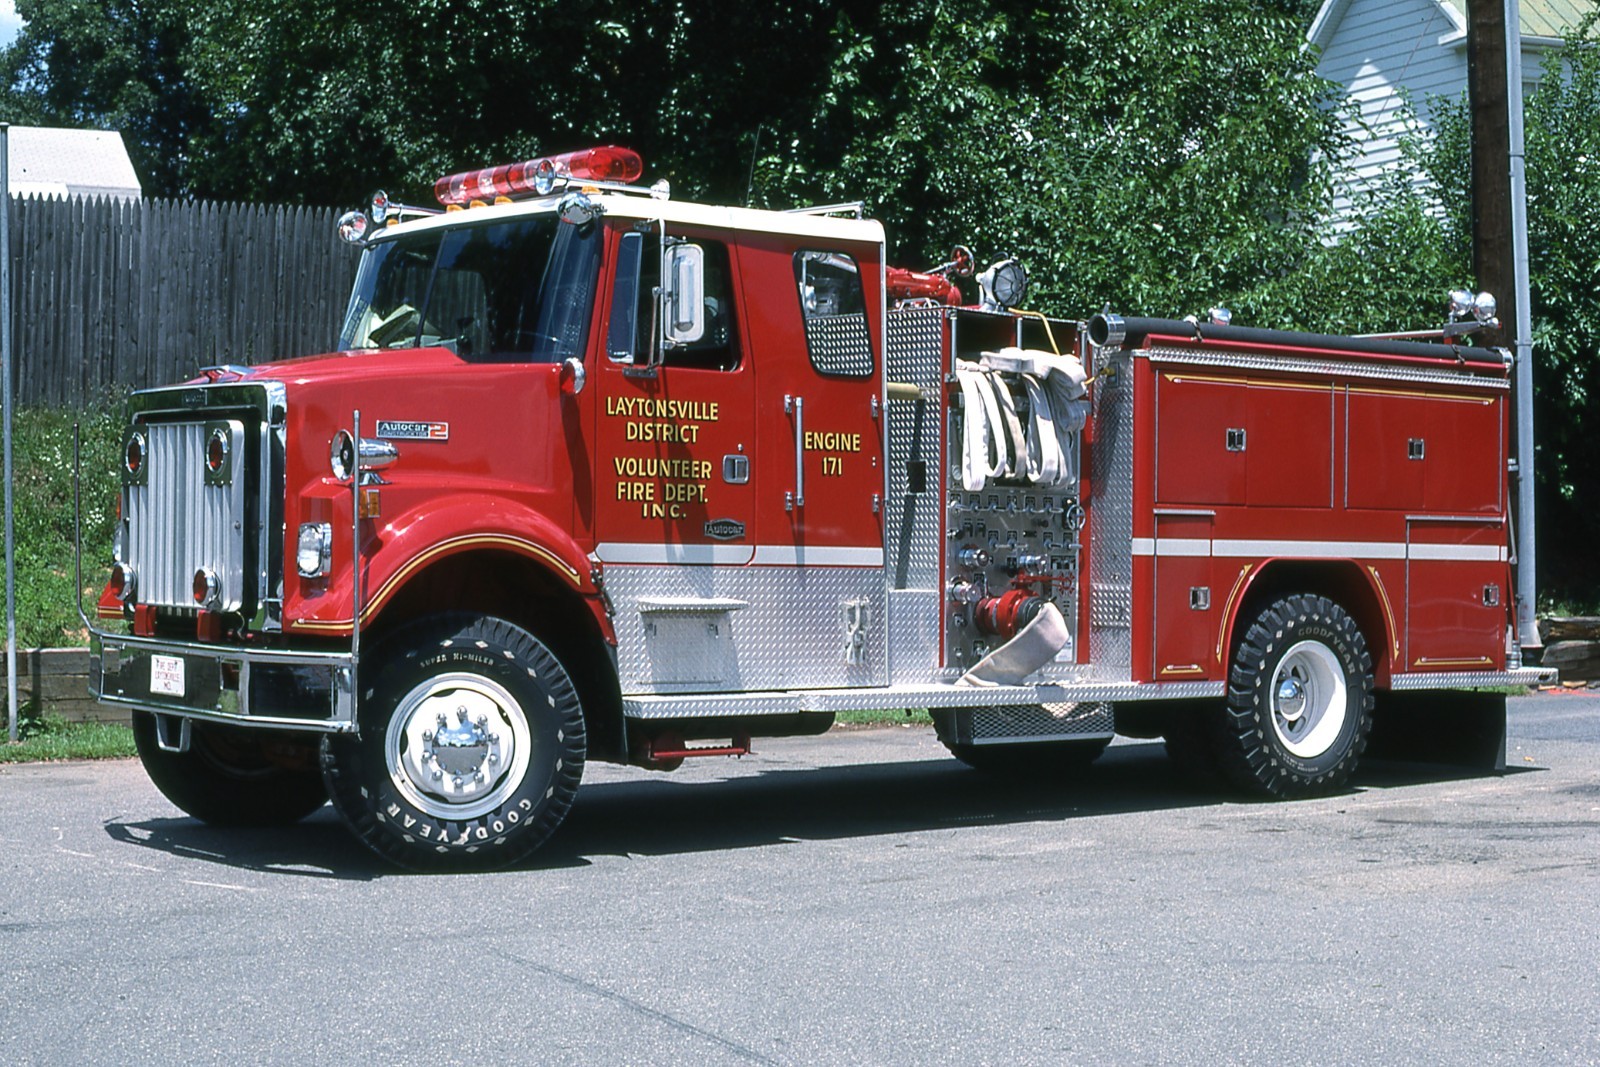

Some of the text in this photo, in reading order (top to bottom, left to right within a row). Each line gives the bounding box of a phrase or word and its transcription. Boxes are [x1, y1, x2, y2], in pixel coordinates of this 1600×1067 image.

[607, 396, 719, 421] LAYTONSVILLE
[380, 423, 427, 431] Autocar
[626, 421, 700, 443] DISTRICT
[804, 431, 861, 452] ENGINE
[614, 457, 713, 480] VOLUNTEER
[822, 456, 843, 476] 171
[617, 481, 709, 503] FIRE DEPT.
[642, 503, 687, 518] INC.
[708, 525, 743, 535] Autocar
[420, 653, 447, 668] SUPER
[1298, 626, 1356, 675] GOODYEAR
[386, 798, 533, 845] GOODYEAR
